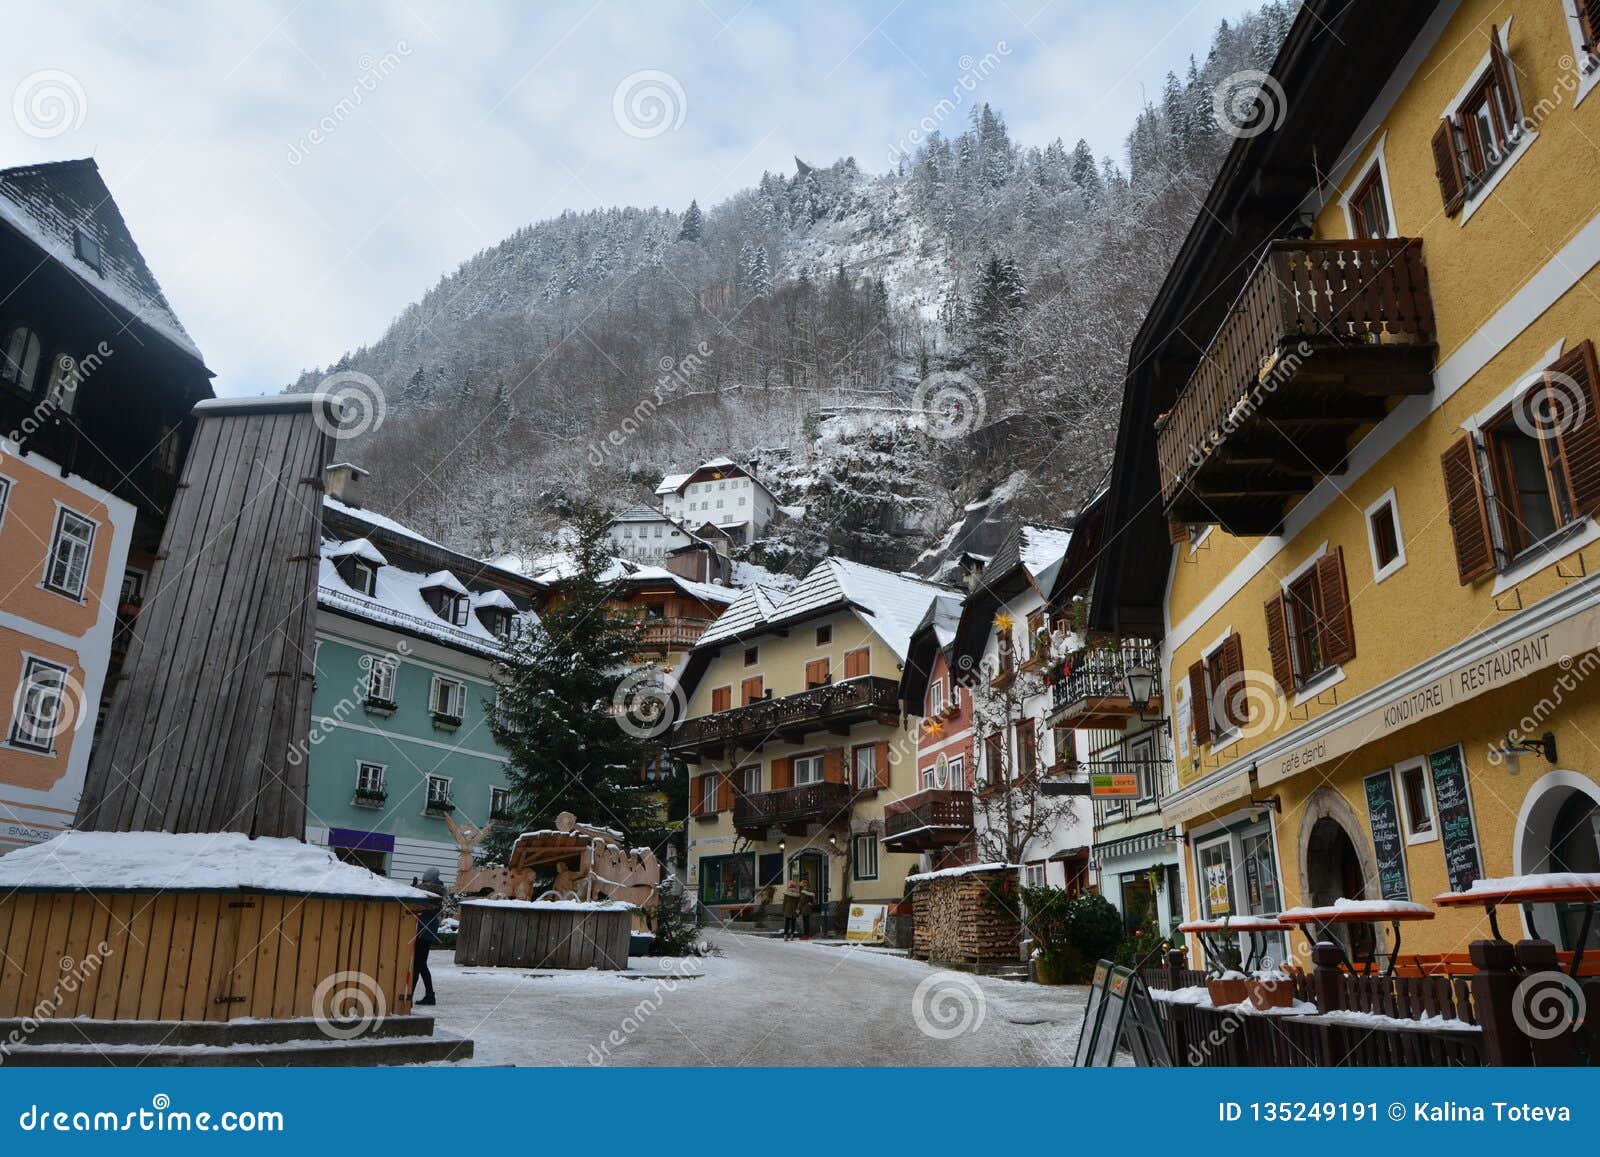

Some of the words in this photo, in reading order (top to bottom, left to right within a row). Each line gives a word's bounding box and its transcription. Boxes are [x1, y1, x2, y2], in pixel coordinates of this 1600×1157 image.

[1383, 684, 1444, 728] KONDITOREI
[1460, 634, 1549, 694] RESTAURANT
[8, 826, 50, 840] SNACKS
